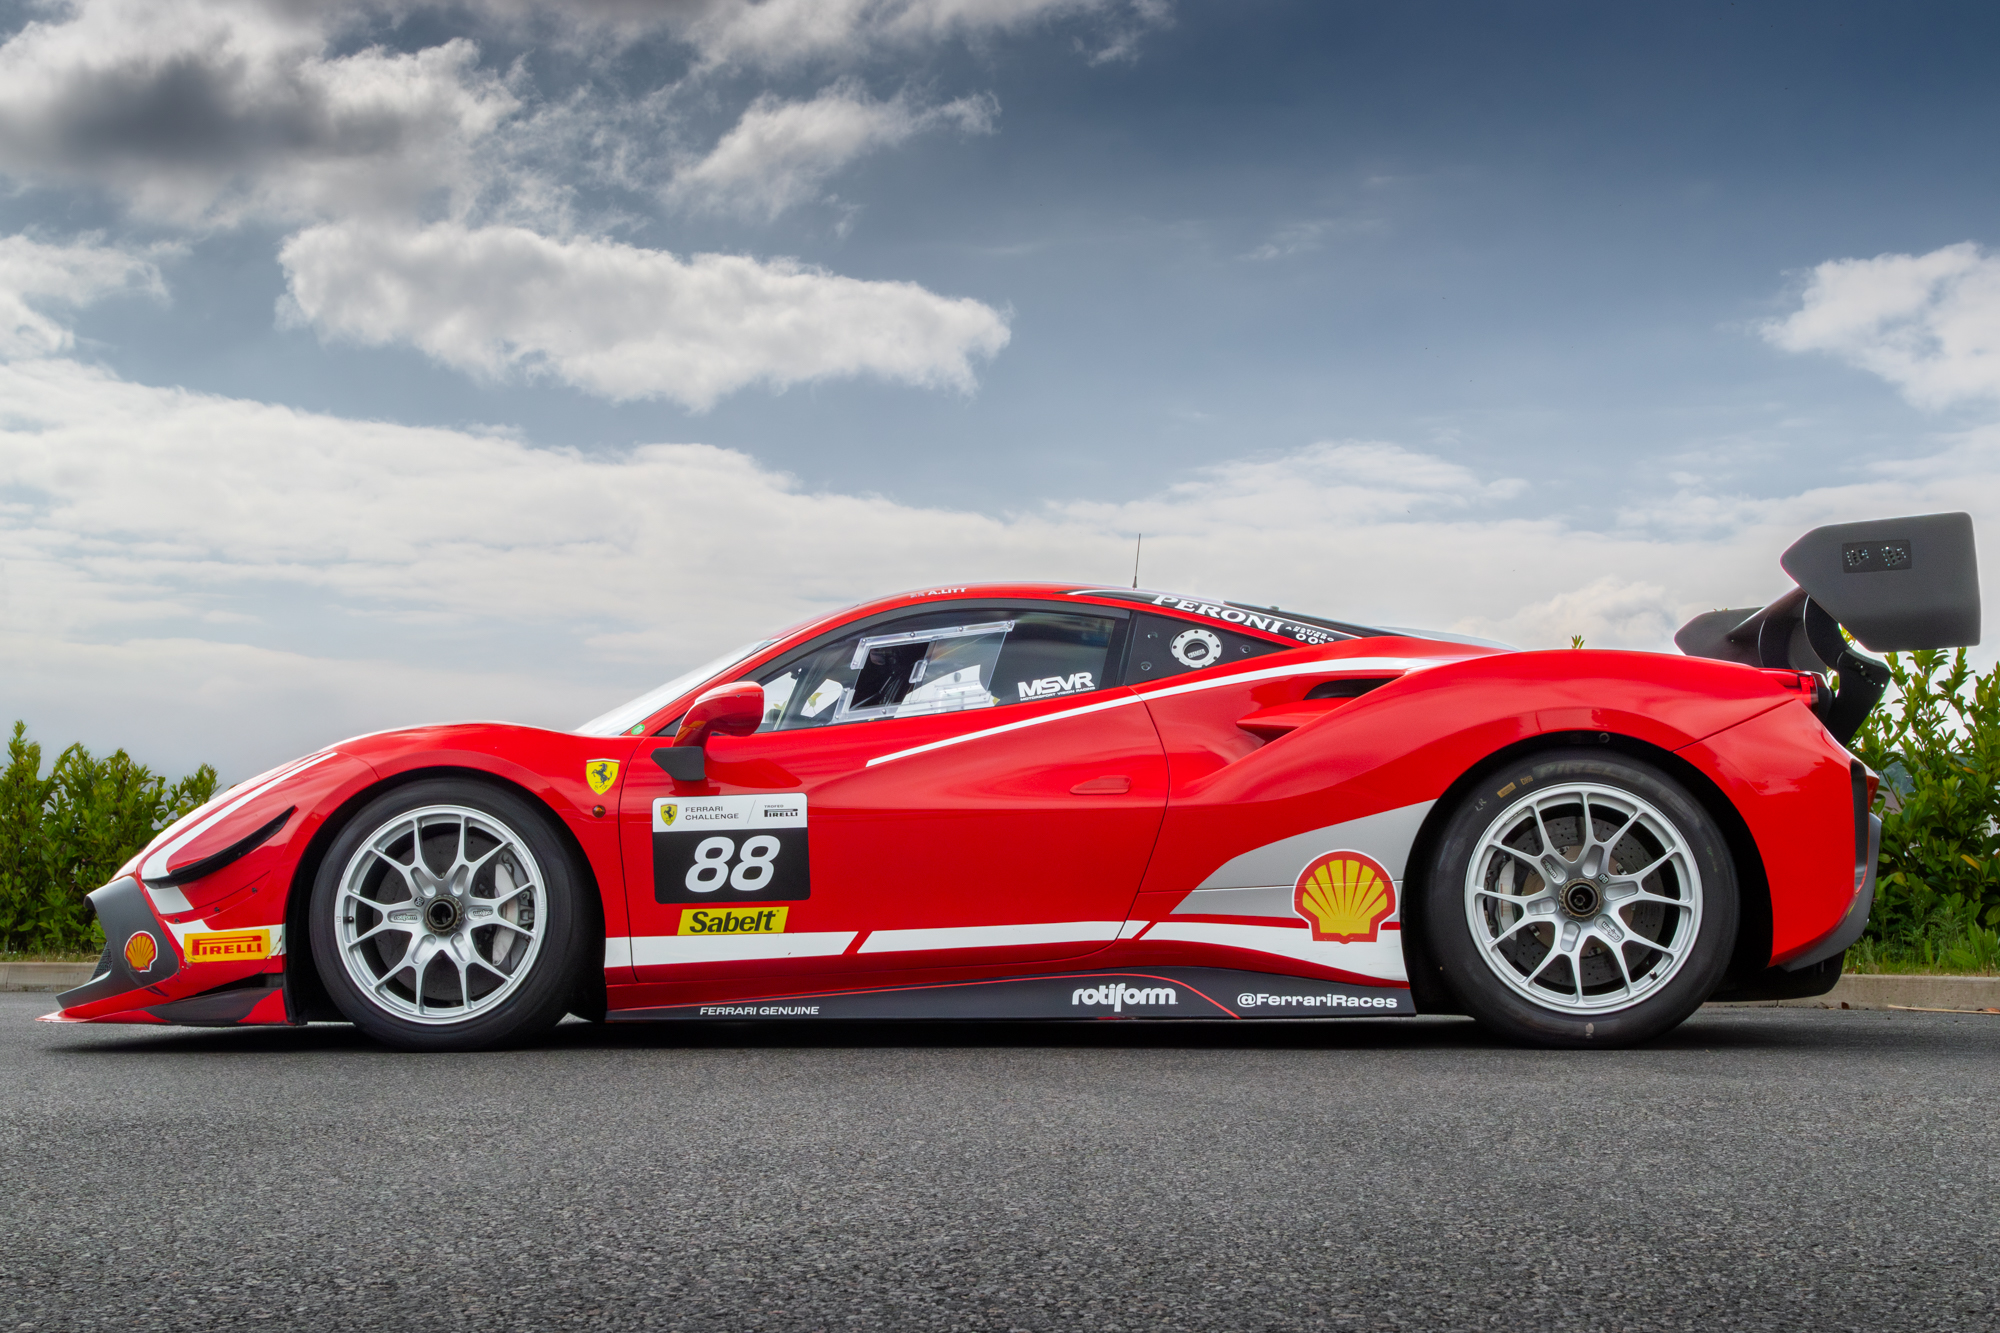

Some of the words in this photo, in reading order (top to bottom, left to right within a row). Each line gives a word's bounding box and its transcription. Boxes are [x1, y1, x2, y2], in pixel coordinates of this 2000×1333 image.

[1151, 594, 1285, 634] PERONI
[1017, 672, 1095, 698] MSVR
[685, 805, 724, 813] FERRARI
[685, 813, 740, 821] CHALLENGE
[763, 808, 799, 818] PIRELLI
[685, 835, 781, 893] 88
[689, 909, 776, 934] Sabelt
[191, 935, 263, 956] PIRELLI
[1072, 982, 1177, 1013] rotiform
[1236, 992, 1398, 1009] @FerrariRaces
[699, 1006, 757, 1016] FERRARI
[759, 1006, 820, 1015] GENUINE
